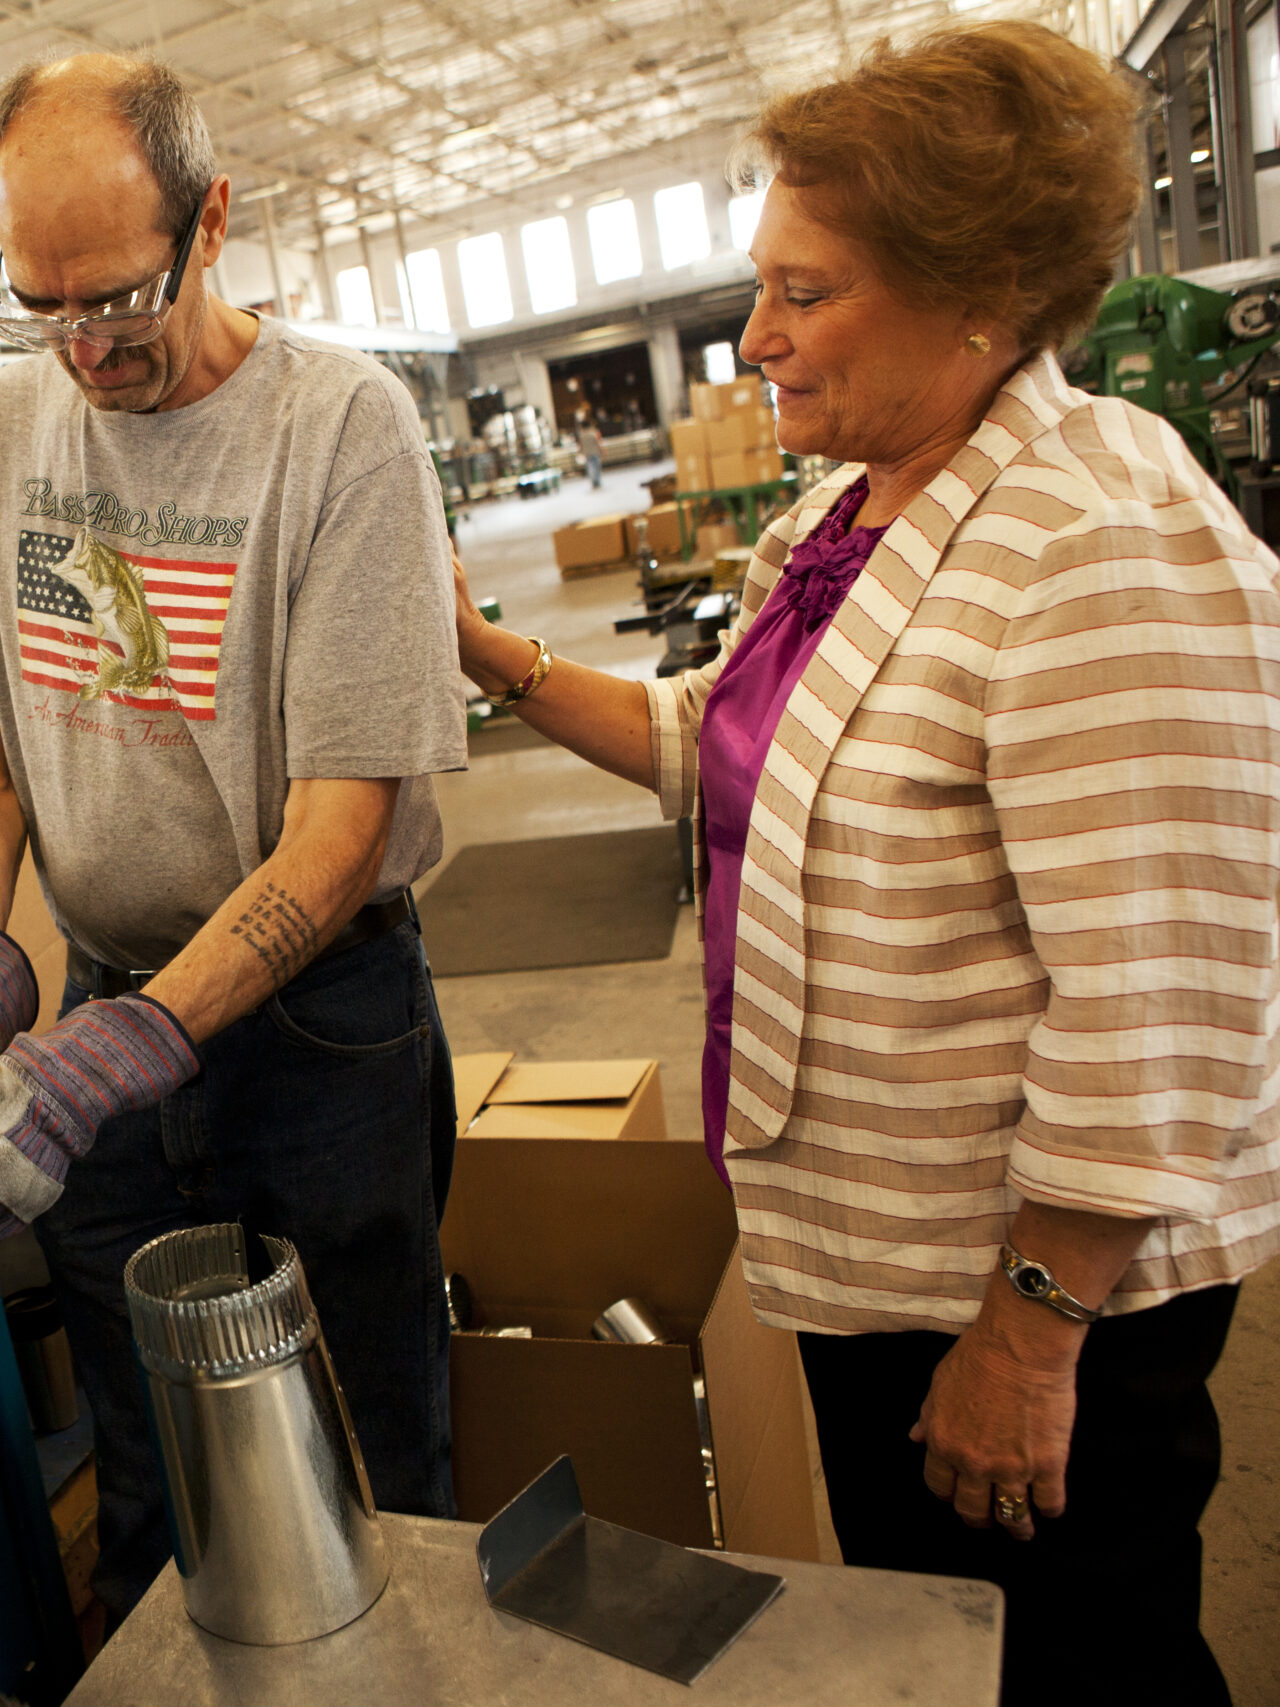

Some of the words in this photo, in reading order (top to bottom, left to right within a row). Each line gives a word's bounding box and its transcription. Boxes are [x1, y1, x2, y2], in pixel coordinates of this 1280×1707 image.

[20, 478, 87, 524] BASS
[84, 490, 148, 537] PRO
[139, 501, 248, 546] SHOPS
[28, 696, 52, 721] An
